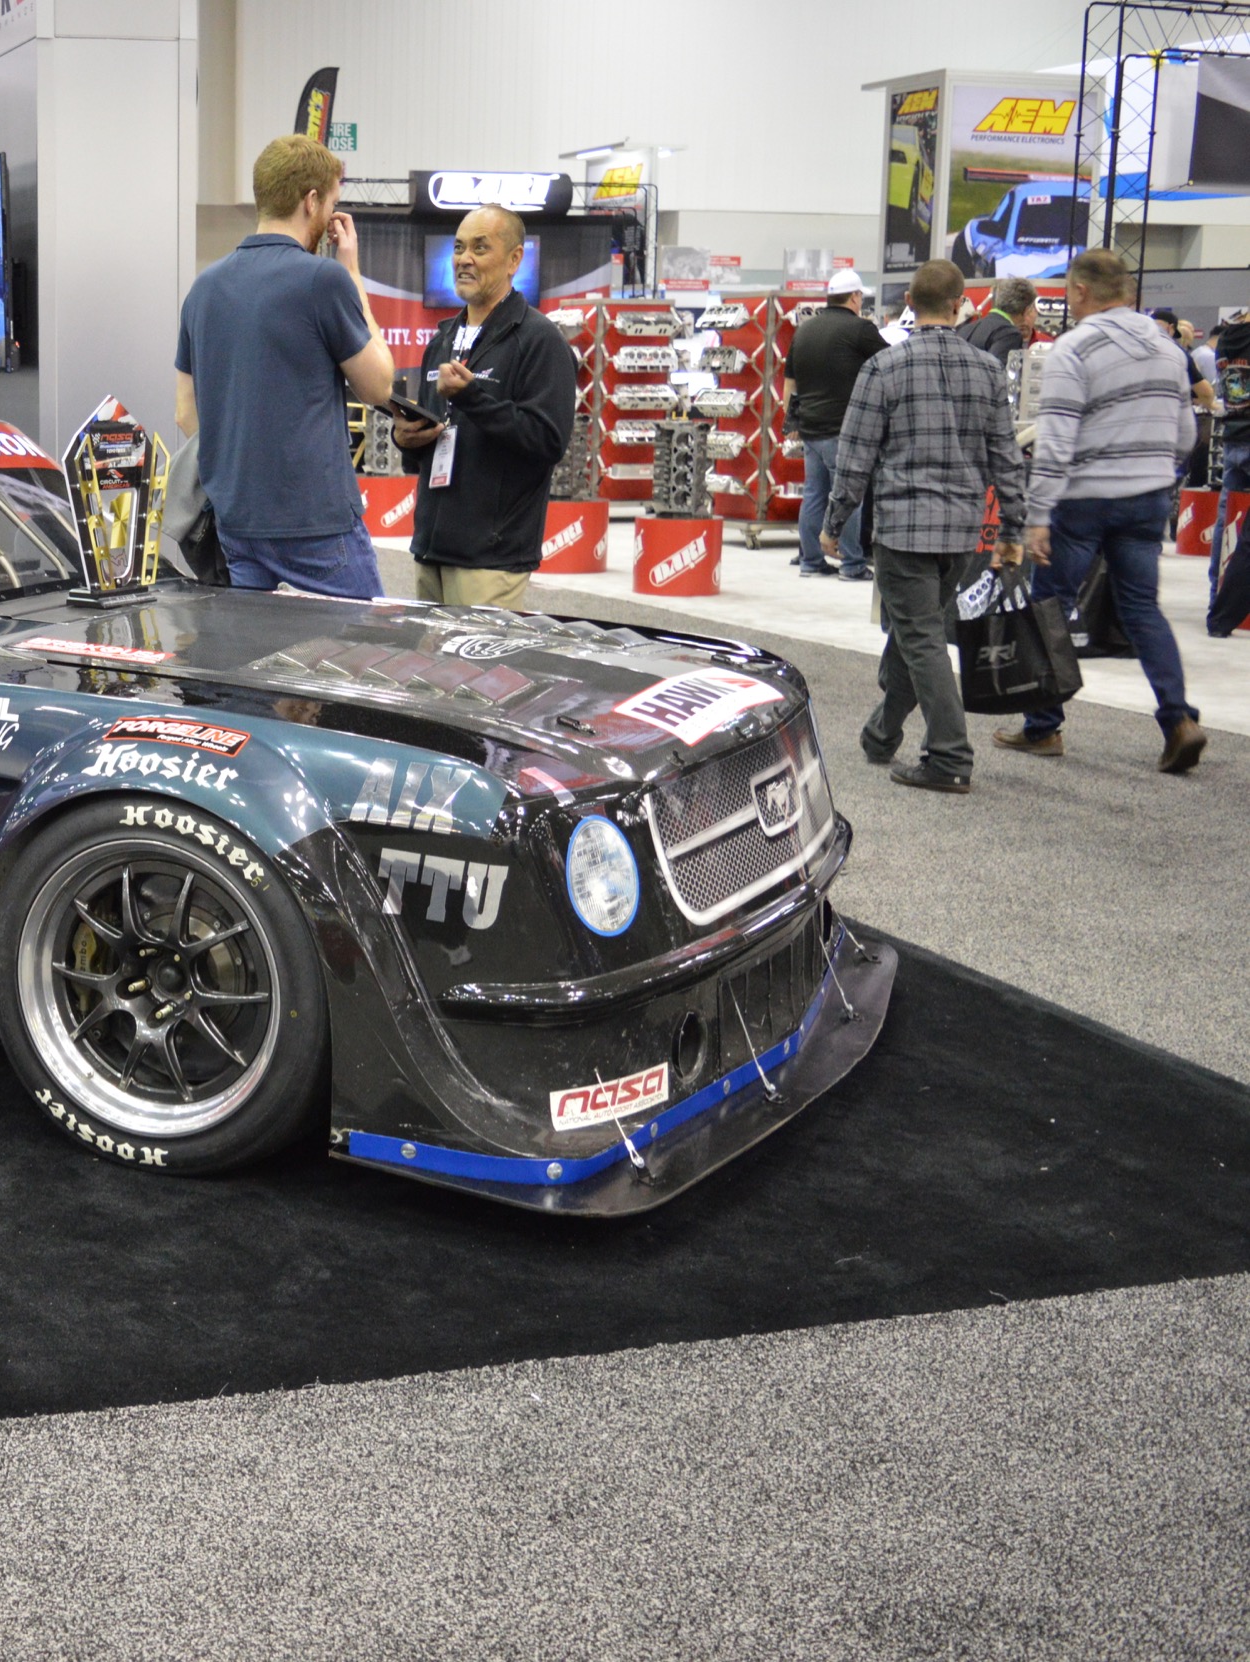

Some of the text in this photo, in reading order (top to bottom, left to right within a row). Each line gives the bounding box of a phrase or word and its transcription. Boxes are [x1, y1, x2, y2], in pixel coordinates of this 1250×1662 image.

[897, 88, 939, 115] AEM
[973, 97, 1077, 136] AEM
[971, 134, 1065, 145] PERFORMANCE ELECTRONICS
[593, 163, 643, 200] AEM
[382, 328, 411, 346] LITY.
[631, 677, 738, 728] HAWK
[113, 720, 247, 747] FORGELINE
[81, 742, 240, 791] Hoosier
[349, 757, 472, 835] AIX
[119, 805, 265, 881] Hoosier
[378, 847, 510, 930] TTU
[556, 1067, 664, 1118] nasa
[35, 1088, 169, 1167] Hoosier
